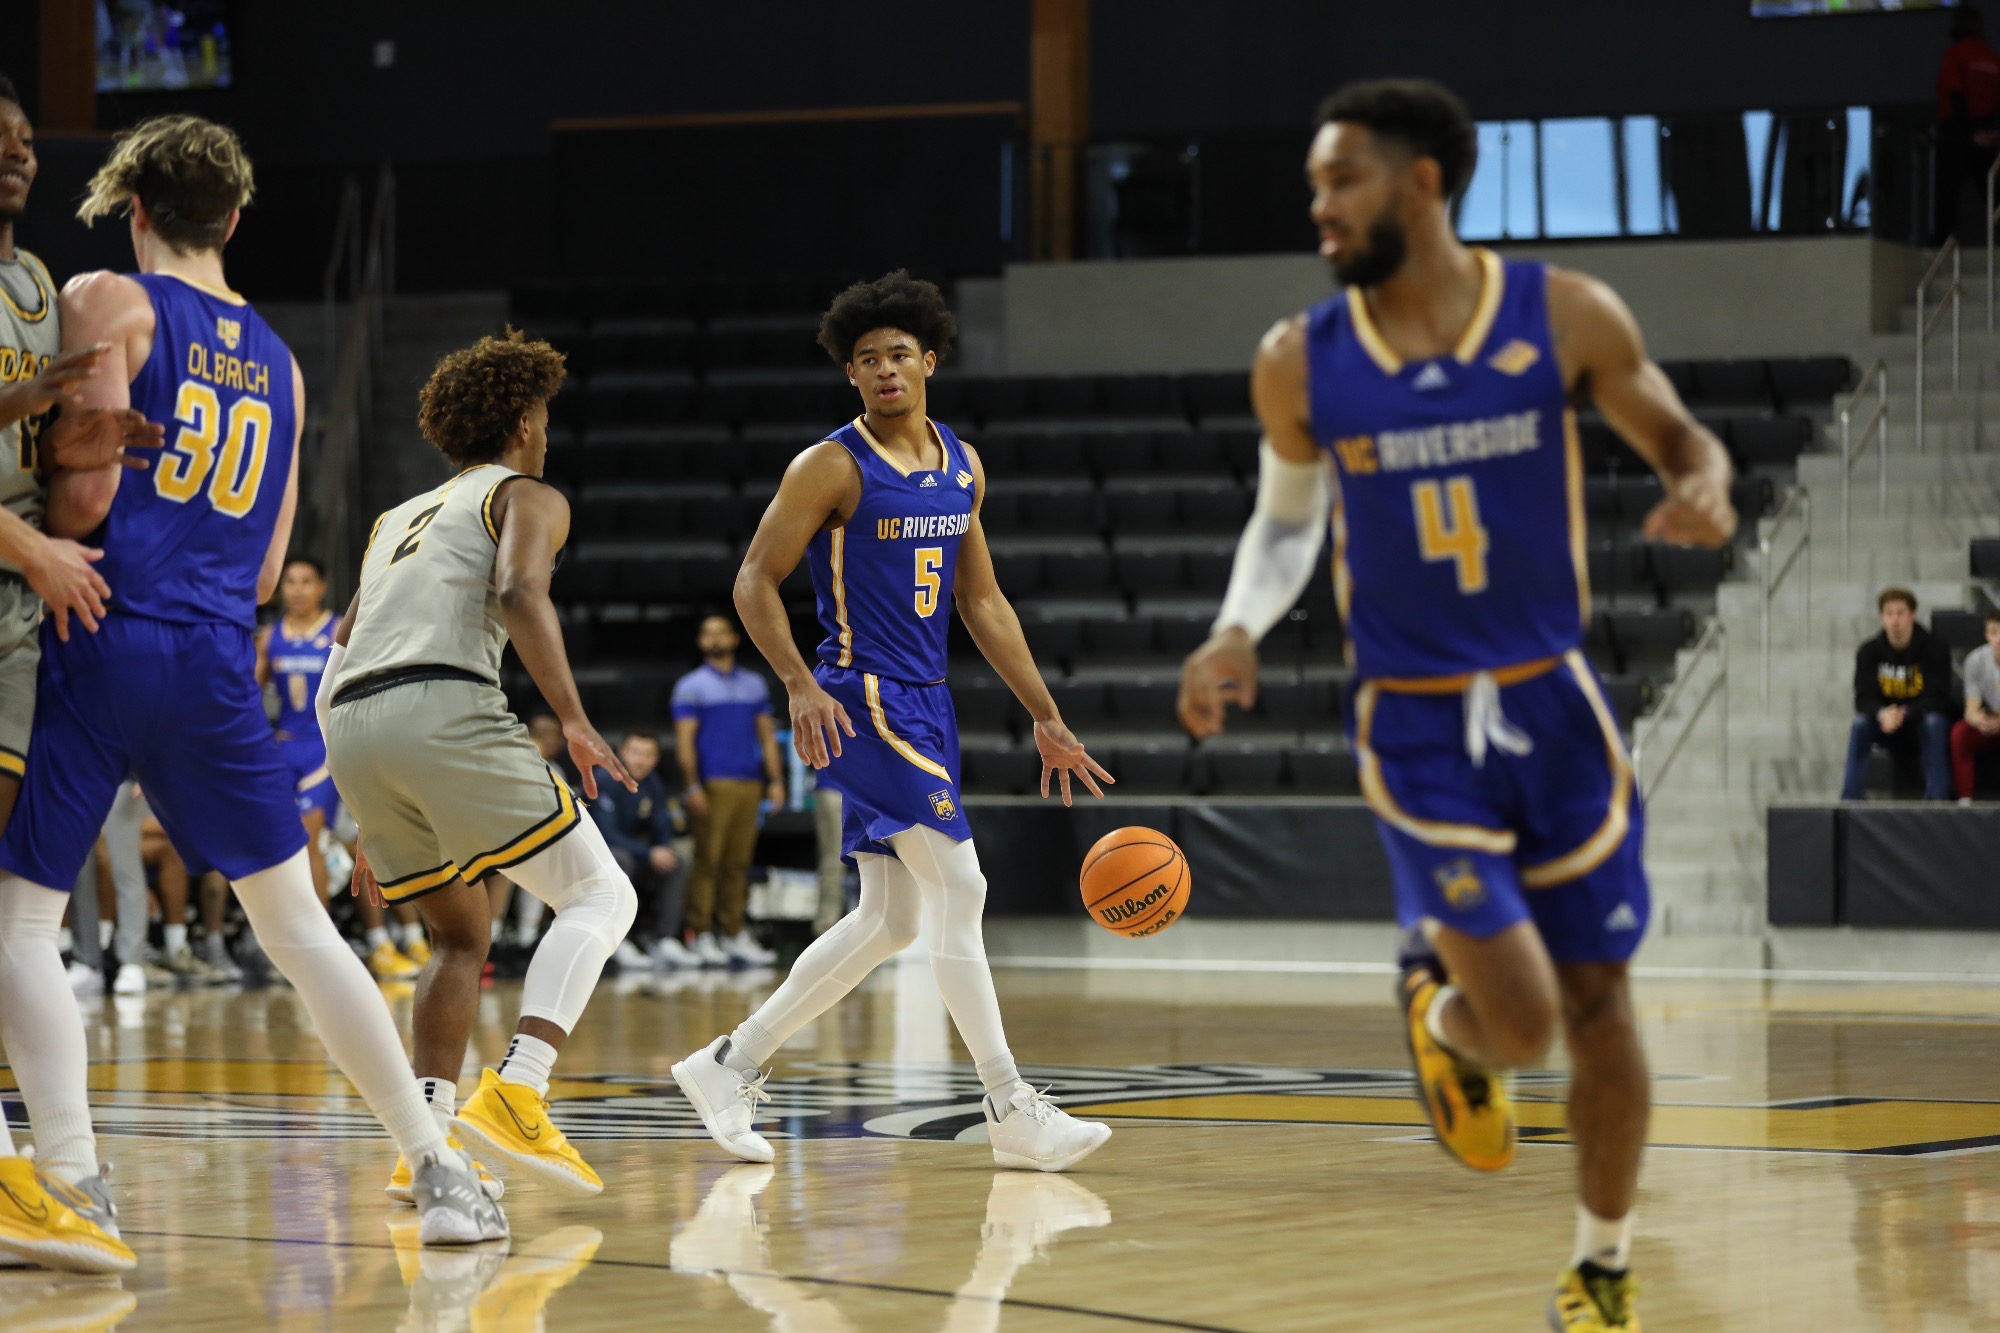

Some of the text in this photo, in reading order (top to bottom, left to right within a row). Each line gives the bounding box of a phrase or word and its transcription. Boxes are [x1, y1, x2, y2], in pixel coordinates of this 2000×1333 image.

[187, 341, 269, 396] OLBRICH
[153, 379, 272, 519] 30
[1376, 408, 1542, 473] RIVERSIDE
[388, 500, 446, 569] 2
[877, 518, 900, 540] UC
[1410, 474, 1489, 594] 4
[914, 546, 943, 619] 5
[1099, 883, 1169, 924] Wilson
